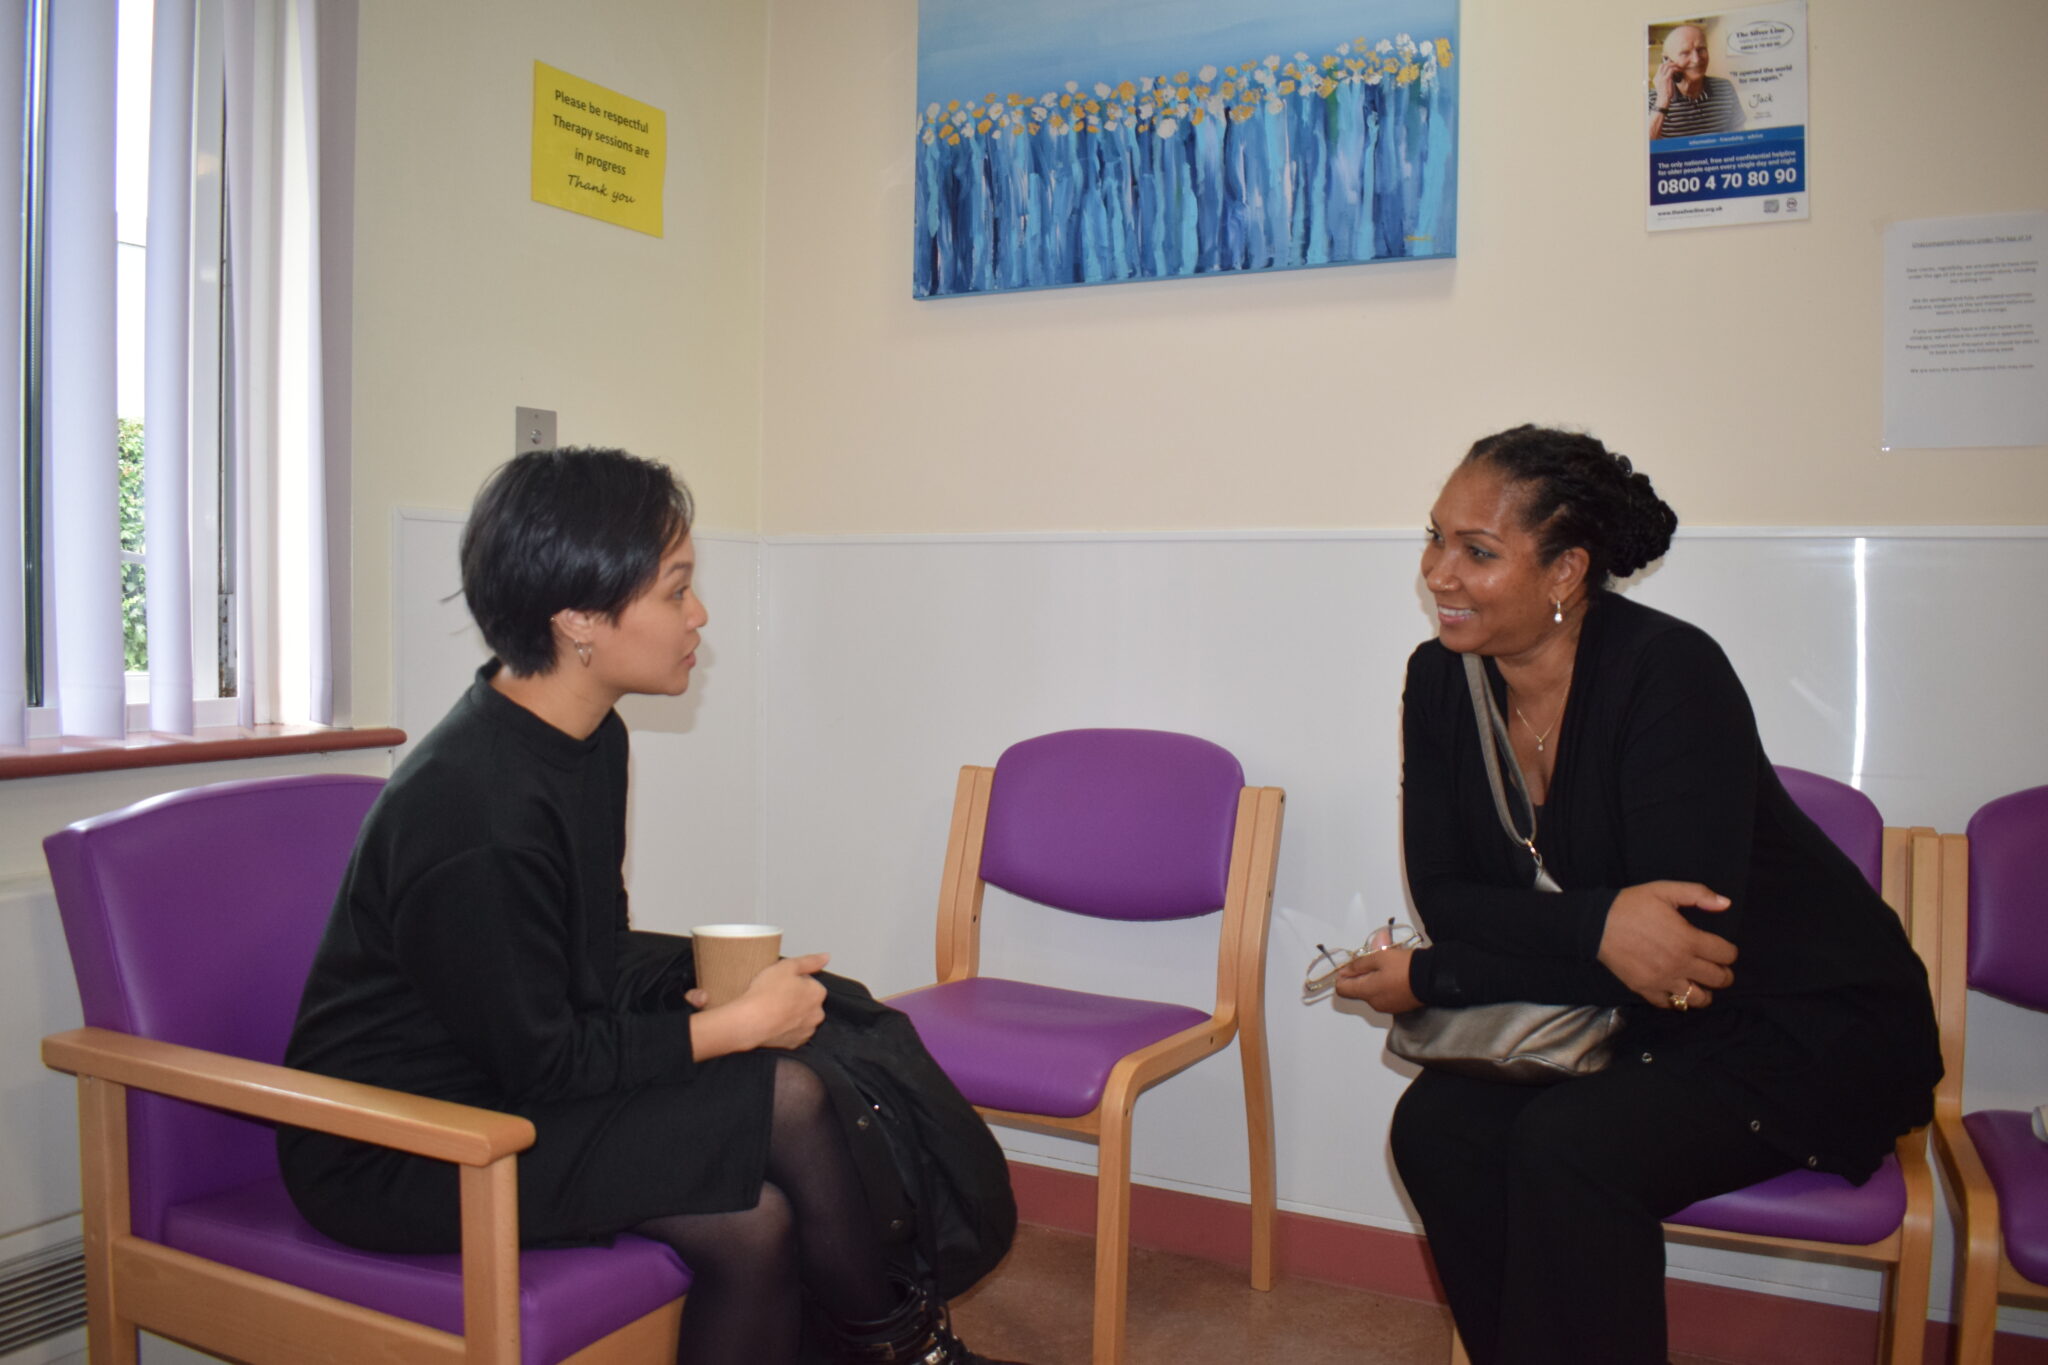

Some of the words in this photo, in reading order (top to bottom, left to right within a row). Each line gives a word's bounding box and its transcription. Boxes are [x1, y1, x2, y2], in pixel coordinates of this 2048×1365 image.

[1750, 29, 1768, 37] Silver
[1769, 26, 1785, 34] Line
[1739, 68, 1762, 77] opened
[1775, 64, 1793, 72] world
[555, 89, 587, 111] Please
[588, 101, 601, 117] be
[603, 110, 649, 134] respectful
[1748, 93, 1773, 109] Jack
[553, 114, 593, 140] Therapy
[595, 132, 633, 153] sessions
[635, 146, 650, 158] are
[574, 148, 584, 161] in
[586, 155, 627, 176] progress
[1683, 167, 1704, 175] people
[1720, 163, 1736, 171] every
[1737, 161, 1755, 169] single
[1768, 158, 1780, 166] and
[1780, 157, 1796, 165] night
[1736, 152, 1771, 161] confidential
[1772, 150, 1796, 158] helpline
[568, 174, 608, 197] Thank
[611, 191, 636, 203] you
[1658, 177, 1700, 195] 0800
[1704, 174, 1717, 190] 4
[1720, 172, 1743, 189] 70
[1747, 170, 1770, 187] 80
[1774, 167, 1797, 184] 90
